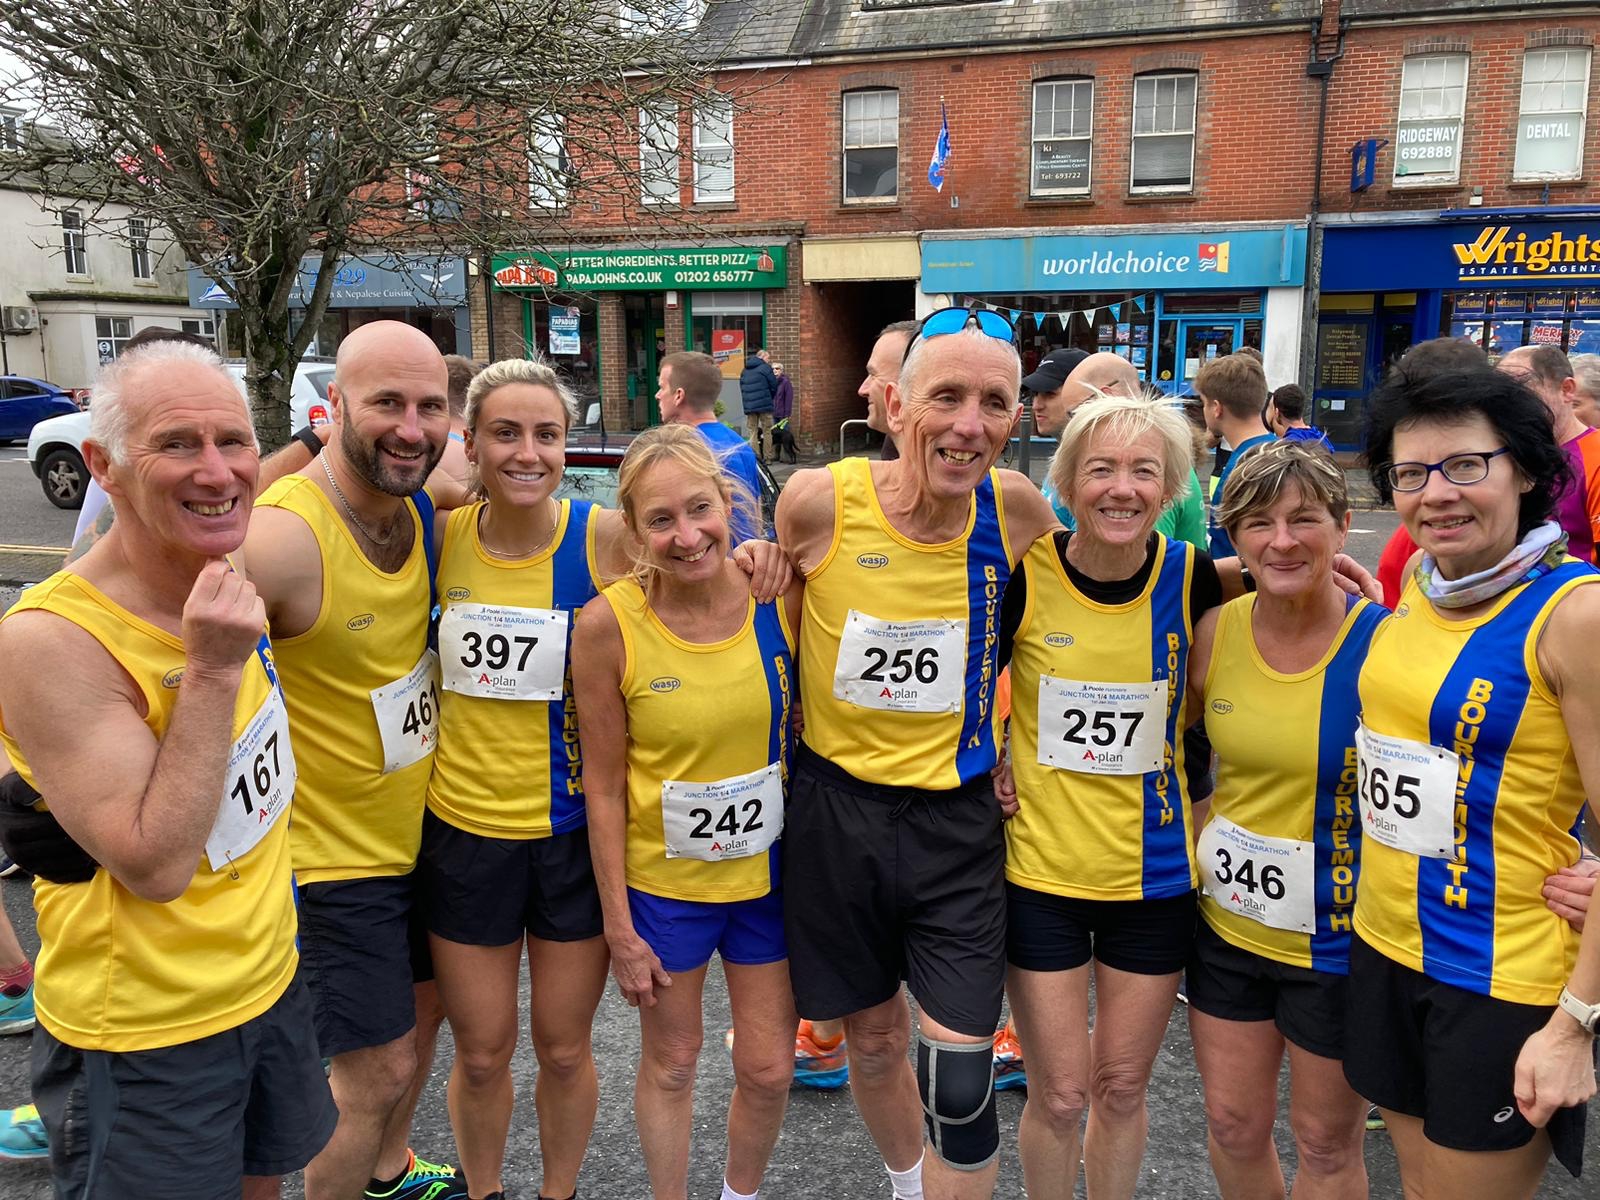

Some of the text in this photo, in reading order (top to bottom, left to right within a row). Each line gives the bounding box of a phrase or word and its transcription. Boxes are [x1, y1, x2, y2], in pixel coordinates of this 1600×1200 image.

[1400, 126, 1458, 143] RIDGEWAY
[1526, 122, 1572, 140] DENTAL
[1401, 145, 1453, 160] 692888
[1453, 226, 1600, 271] Wrights
[680, 254, 720, 266] BETTER
[1042, 250, 1190, 276] worldchoice
[566, 270, 754, 285] PAPAJOHNS.CO.UK 01202 656777
[1460, 264, 1600, 275] ESTATE AGENT
[345, 289, 380, 300] Nepalese
[383, 288, 414, 298] Cuisine
[860, 557, 886, 565] wasp
[460, 614, 492, 622] JUNCTION
[504, 616, 545, 626] MARATHON
[864, 627, 899, 638] JUNCTION
[909, 629, 945, 638] MARATHON
[460, 631, 539, 671] 397
[860, 647, 939, 684] 256
[478, 673, 516, 687] A-plan
[652, 680, 679, 689] wasp
[880, 687, 918, 700] A-plan
[1059, 690, 1096, 699] JUNCTION
[403, 679, 440, 735] 461
[1062, 708, 1144, 747] 257
[1083, 750, 1123, 764] A-plan
[1382, 749, 1430, 765] MARATHON
[231, 730, 281, 815] 167
[683, 791, 719, 799] JUNCTION
[730, 779, 765, 795] MARATHON
[1361, 757, 1421, 819] 265
[258, 788, 282, 824] A-plan
[688, 798, 764, 839] 242
[1367, 810, 1398, 834] A-plan
[710, 840, 748, 852] A-plan
[1249, 842, 1290, 857] MARATHON
[1214, 847, 1286, 900] 346
[1231, 891, 1266, 912] A-plan
